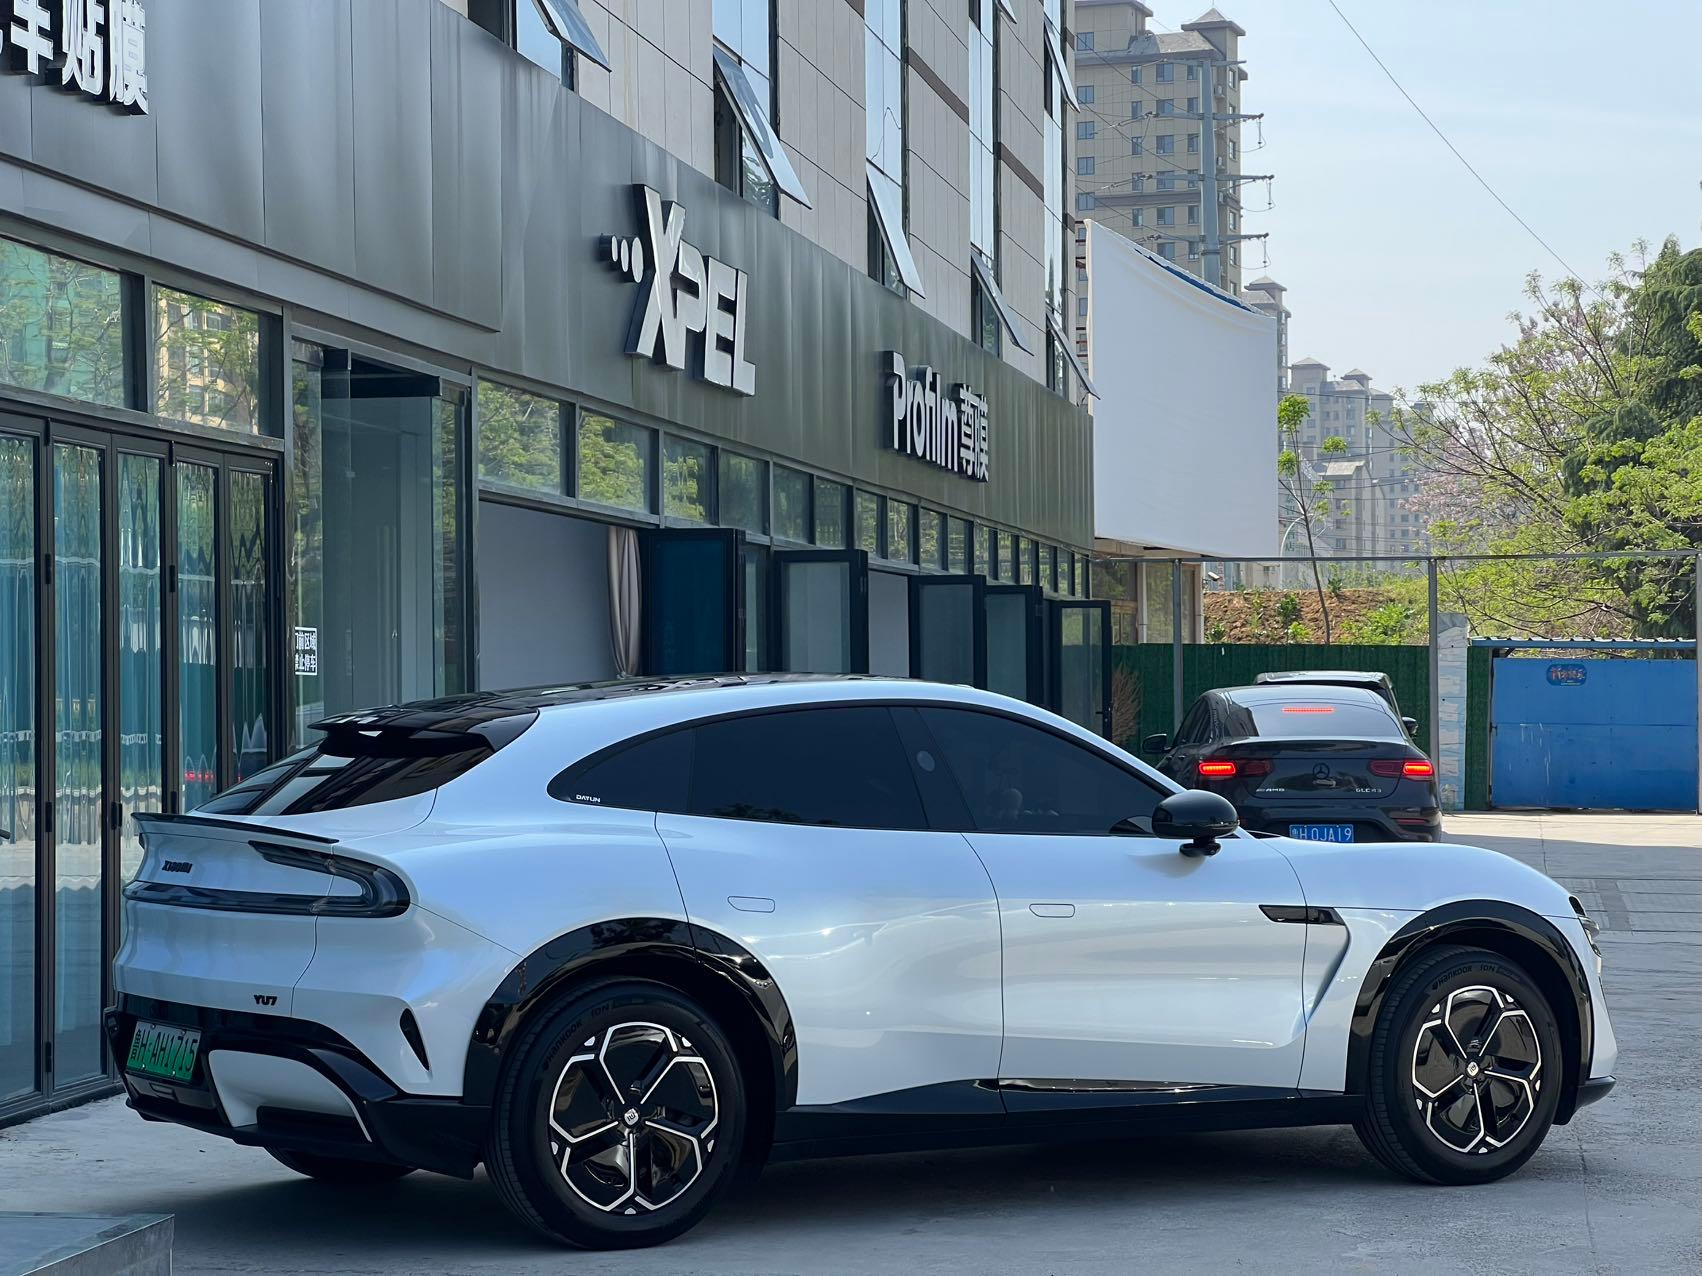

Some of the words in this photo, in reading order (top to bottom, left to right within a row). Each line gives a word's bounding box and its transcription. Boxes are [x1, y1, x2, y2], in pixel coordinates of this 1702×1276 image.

[0, 0, 149, 115] 车贴膜
[635, 184, 756, 396] XPEL
[893, 351, 958, 472] Profilm
[960, 383, 989, 482] 尊膜
[253, 994, 278, 1006] YU7
